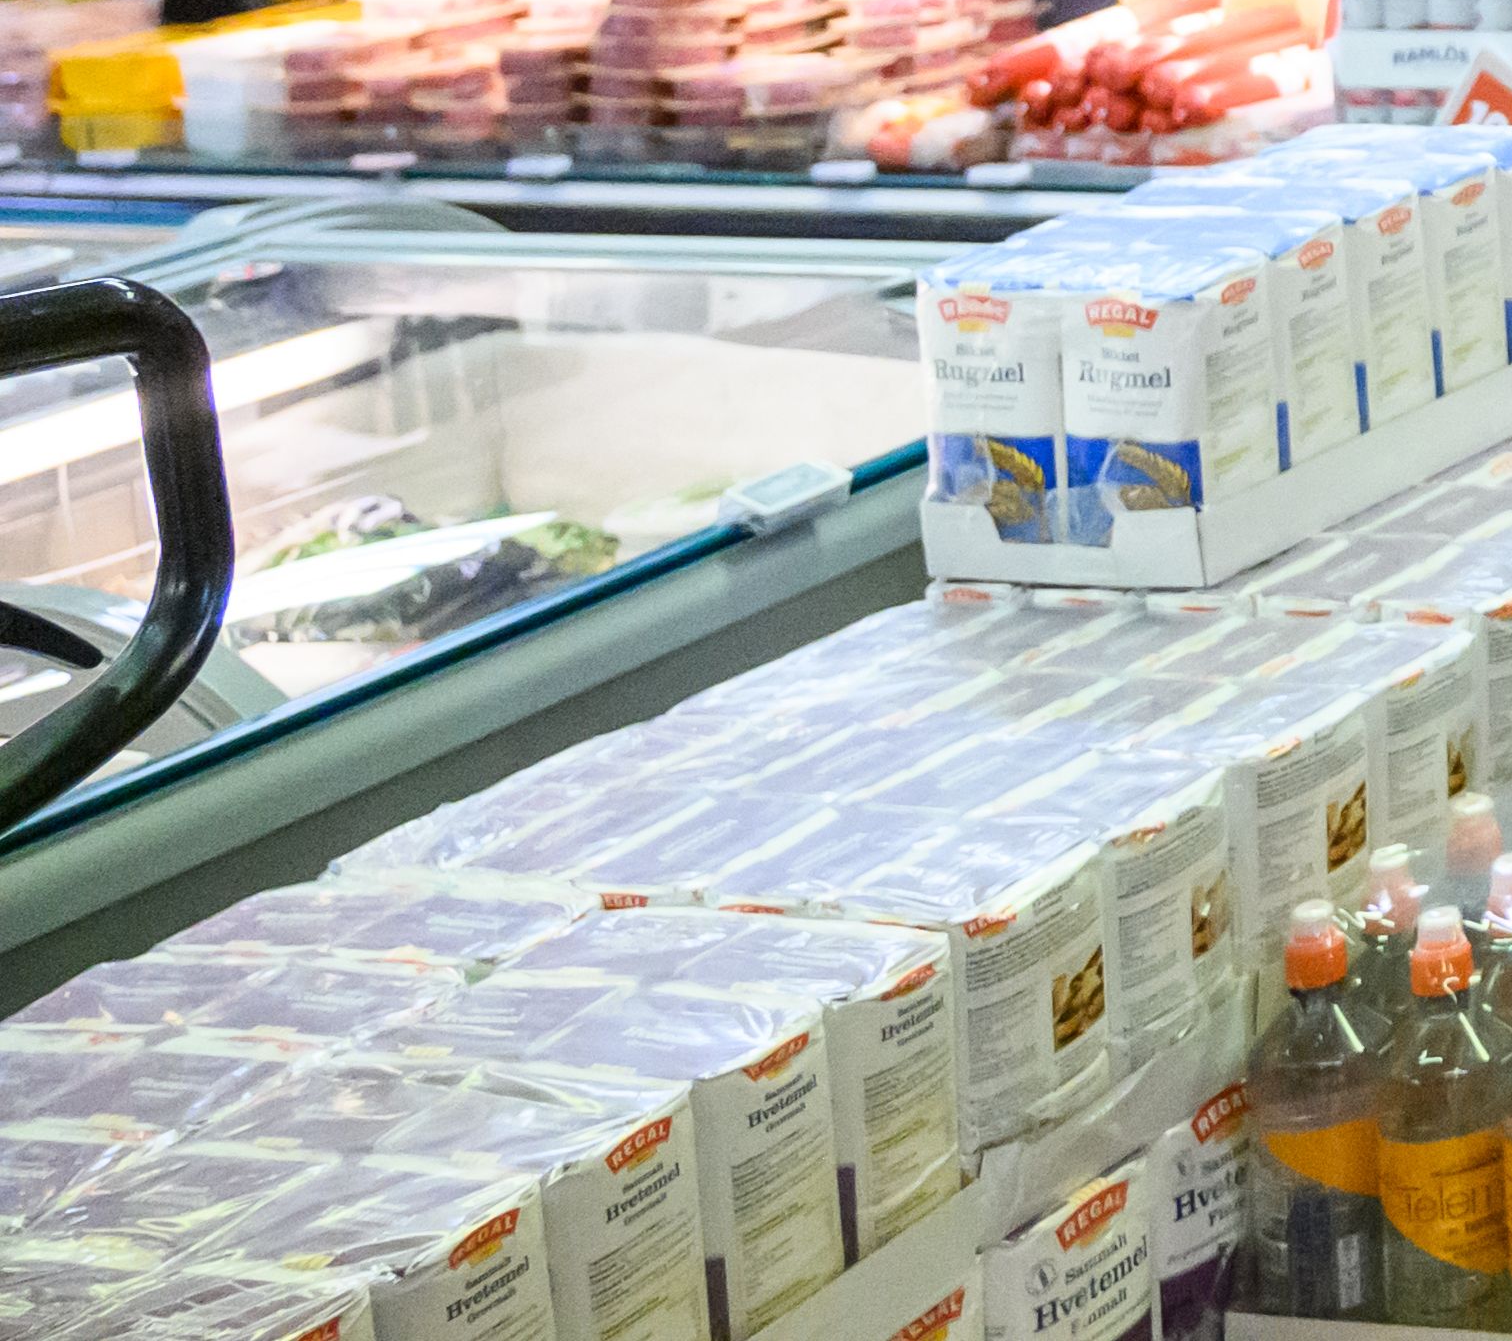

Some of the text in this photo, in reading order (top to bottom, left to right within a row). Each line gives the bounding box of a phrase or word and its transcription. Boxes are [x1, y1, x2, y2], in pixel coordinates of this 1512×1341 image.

[1392, 43, 1470, 67] RAMLÖS
[1088, 302, 1152, 326] REGAL
[611, 1123, 669, 1168] REGAL
[604, 1161, 681, 1225] Hvetemel
[1063, 1184, 1127, 1245] REGAL
[445, 1255, 530, 1322] Hvetemel
[1032, 1236, 1149, 1334] Hvetemel
